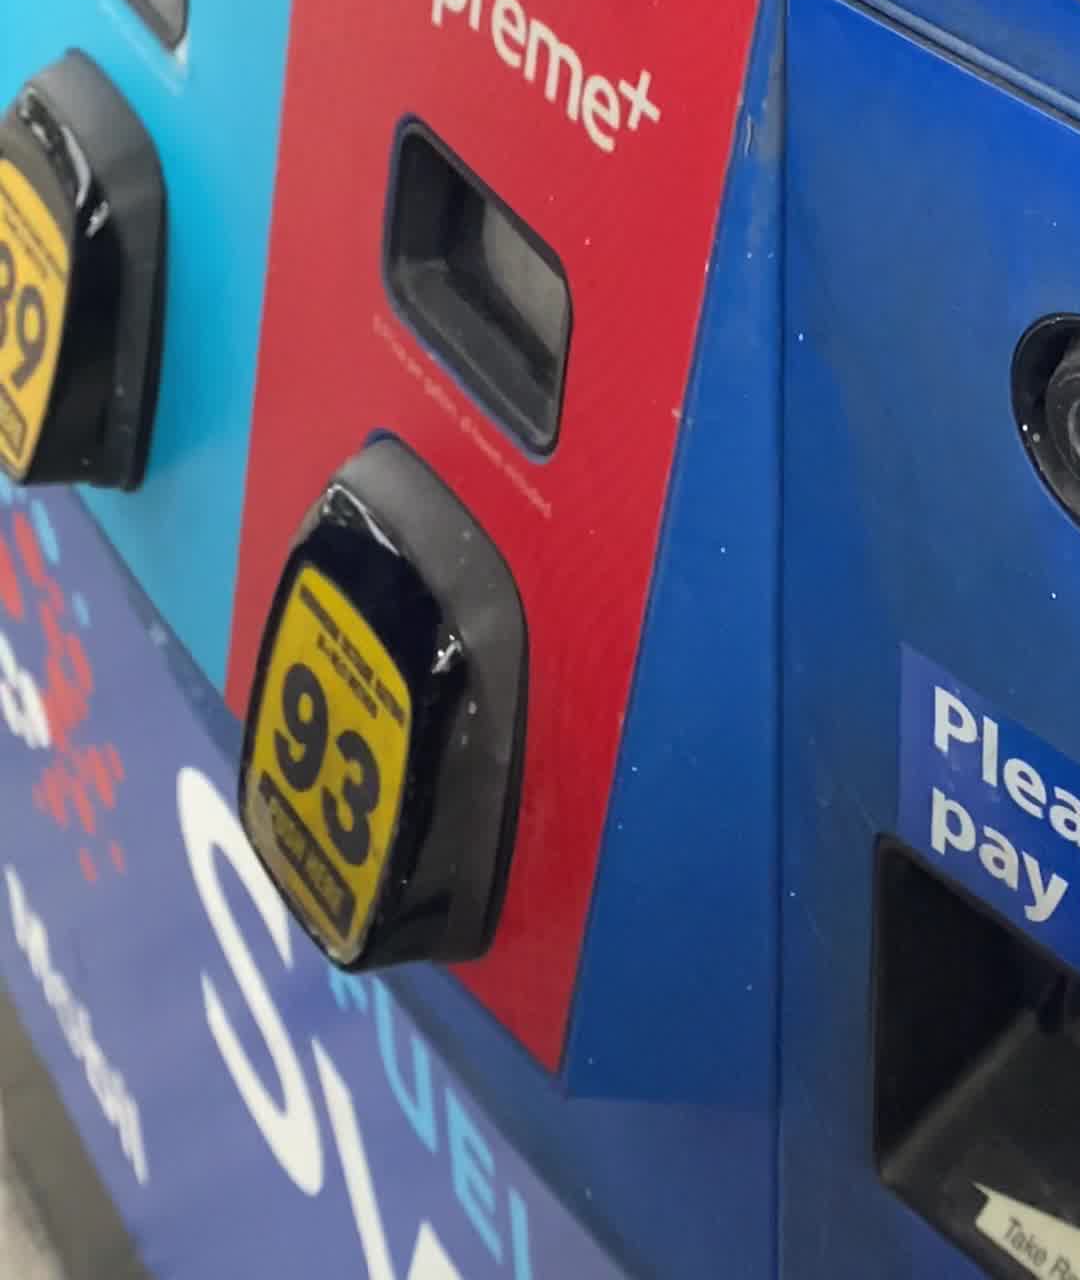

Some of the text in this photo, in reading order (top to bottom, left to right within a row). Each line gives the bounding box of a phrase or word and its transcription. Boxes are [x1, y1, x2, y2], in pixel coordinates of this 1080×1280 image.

[273, 663, 382, 866] 93
[930, 786, 1069, 923] pay
[1004, 1216, 1049, 1267] Take
